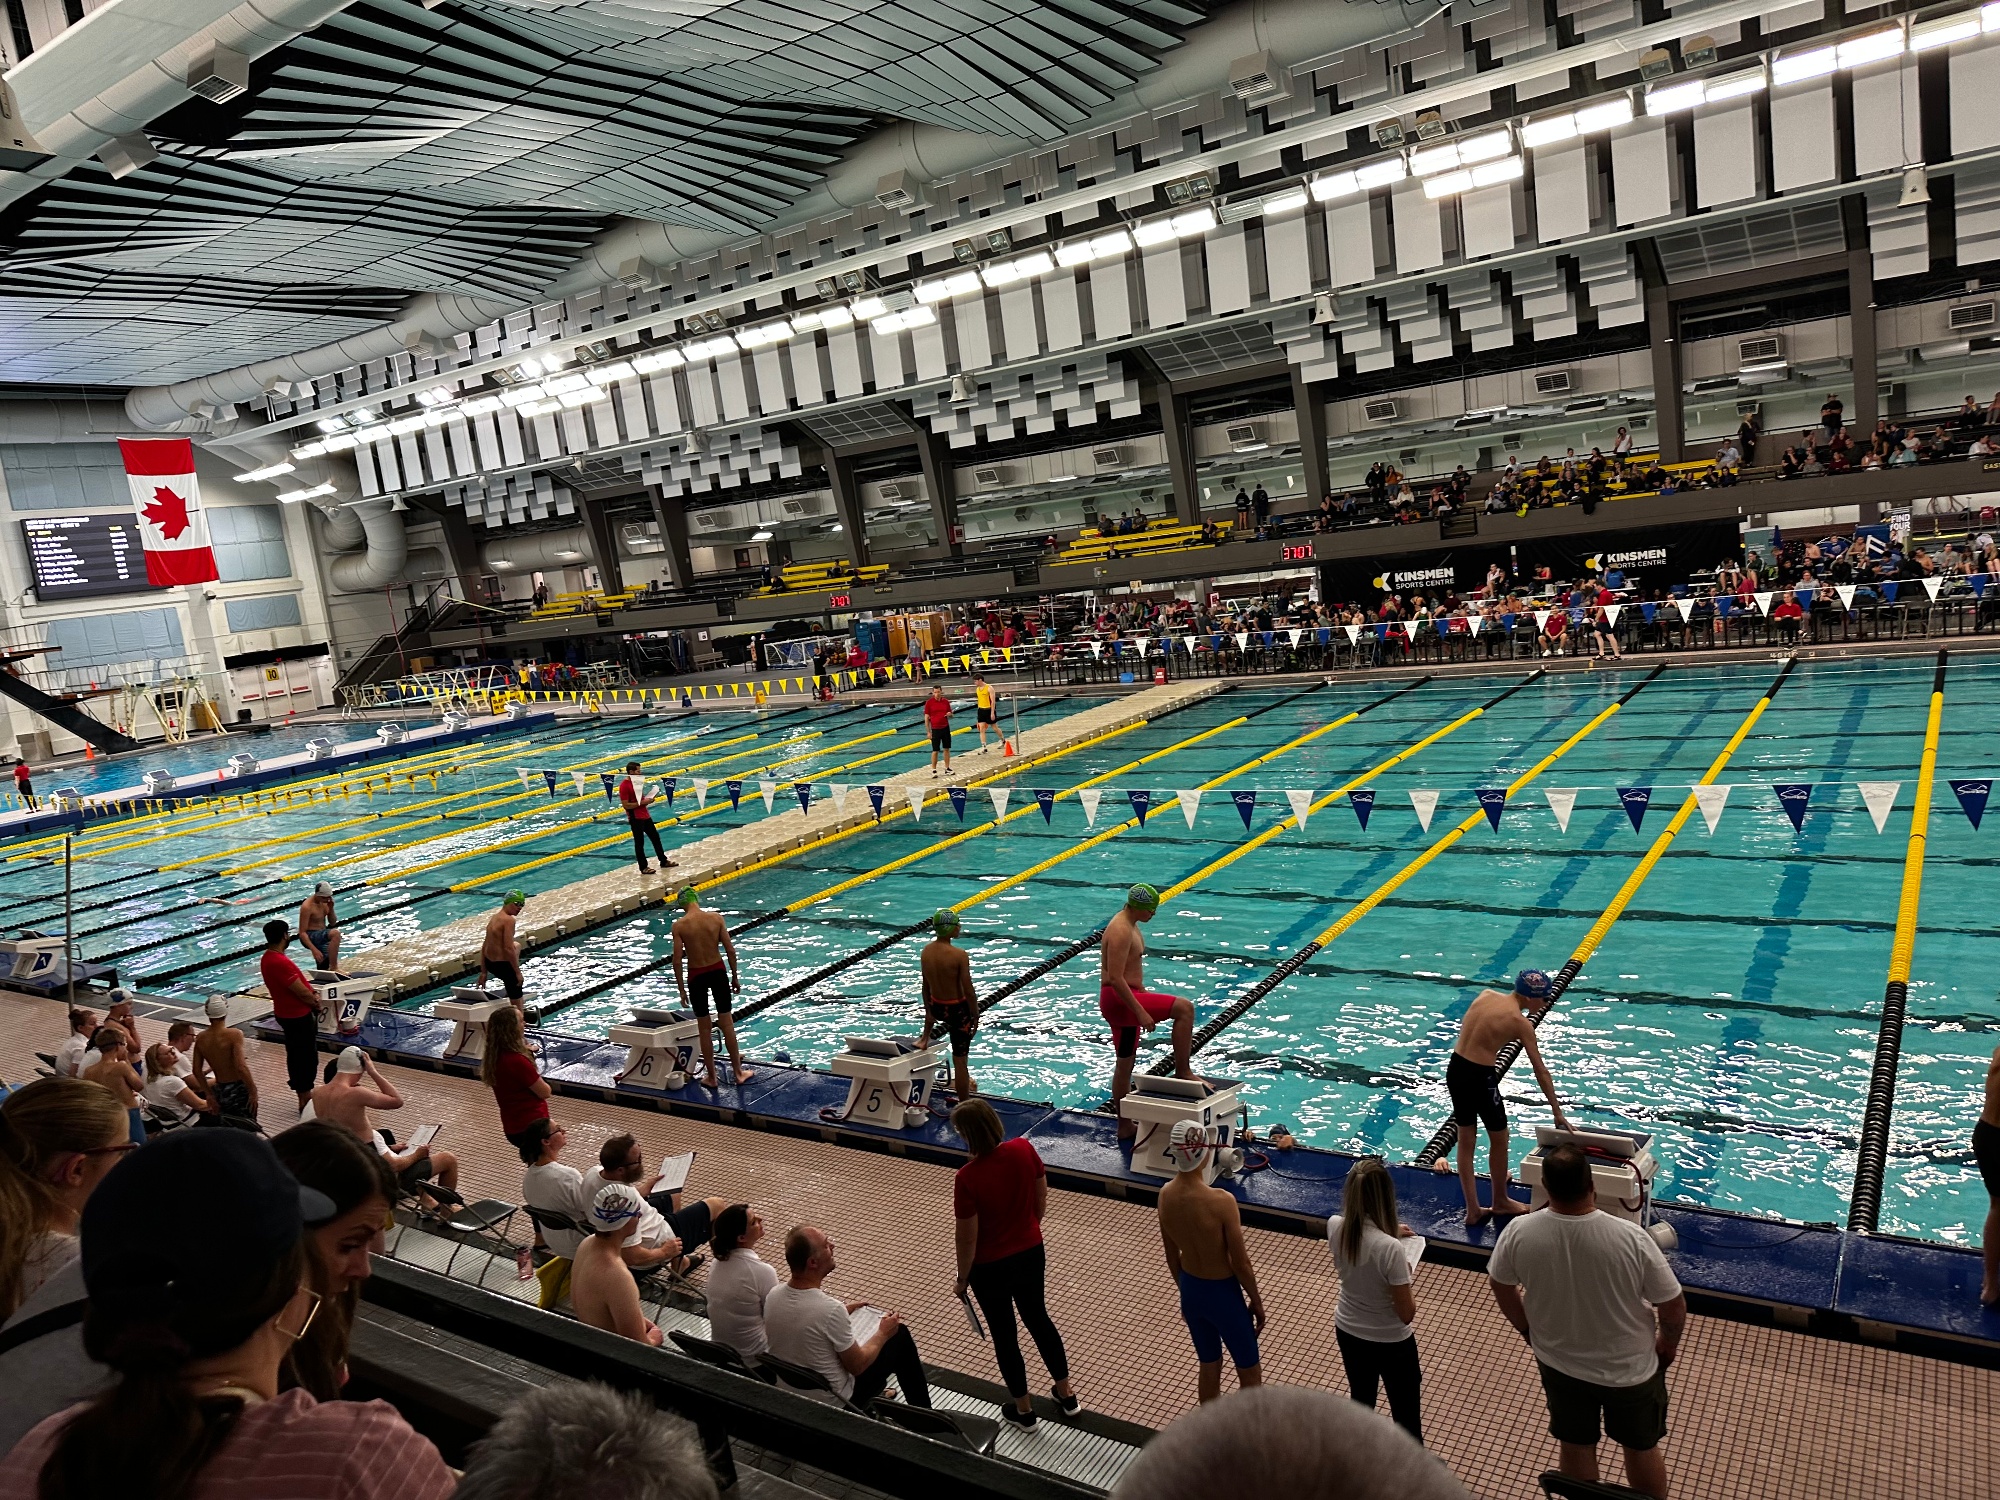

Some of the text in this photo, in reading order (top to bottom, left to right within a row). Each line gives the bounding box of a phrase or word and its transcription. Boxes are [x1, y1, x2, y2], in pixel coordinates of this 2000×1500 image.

[1891, 513, 1911, 524] FIND
[1606, 548, 1667, 563] KINSMEN
[1637, 558, 1667, 567] CENTRE
[1394, 566, 1454, 583] KINSMEN
[1395, 577, 1455, 590] SPORTS CENTRE
[267, 669, 277, 680] 10
[329, 989, 336, 998] 8
[347, 1003, 356, 1017] 8
[462, 1029, 475, 1048] 7
[640, 1055, 654, 1077] 6
[678, 1051, 688, 1067] 6
[866, 1088, 883, 1113] 5
[911, 1085, 920, 1105] 5
